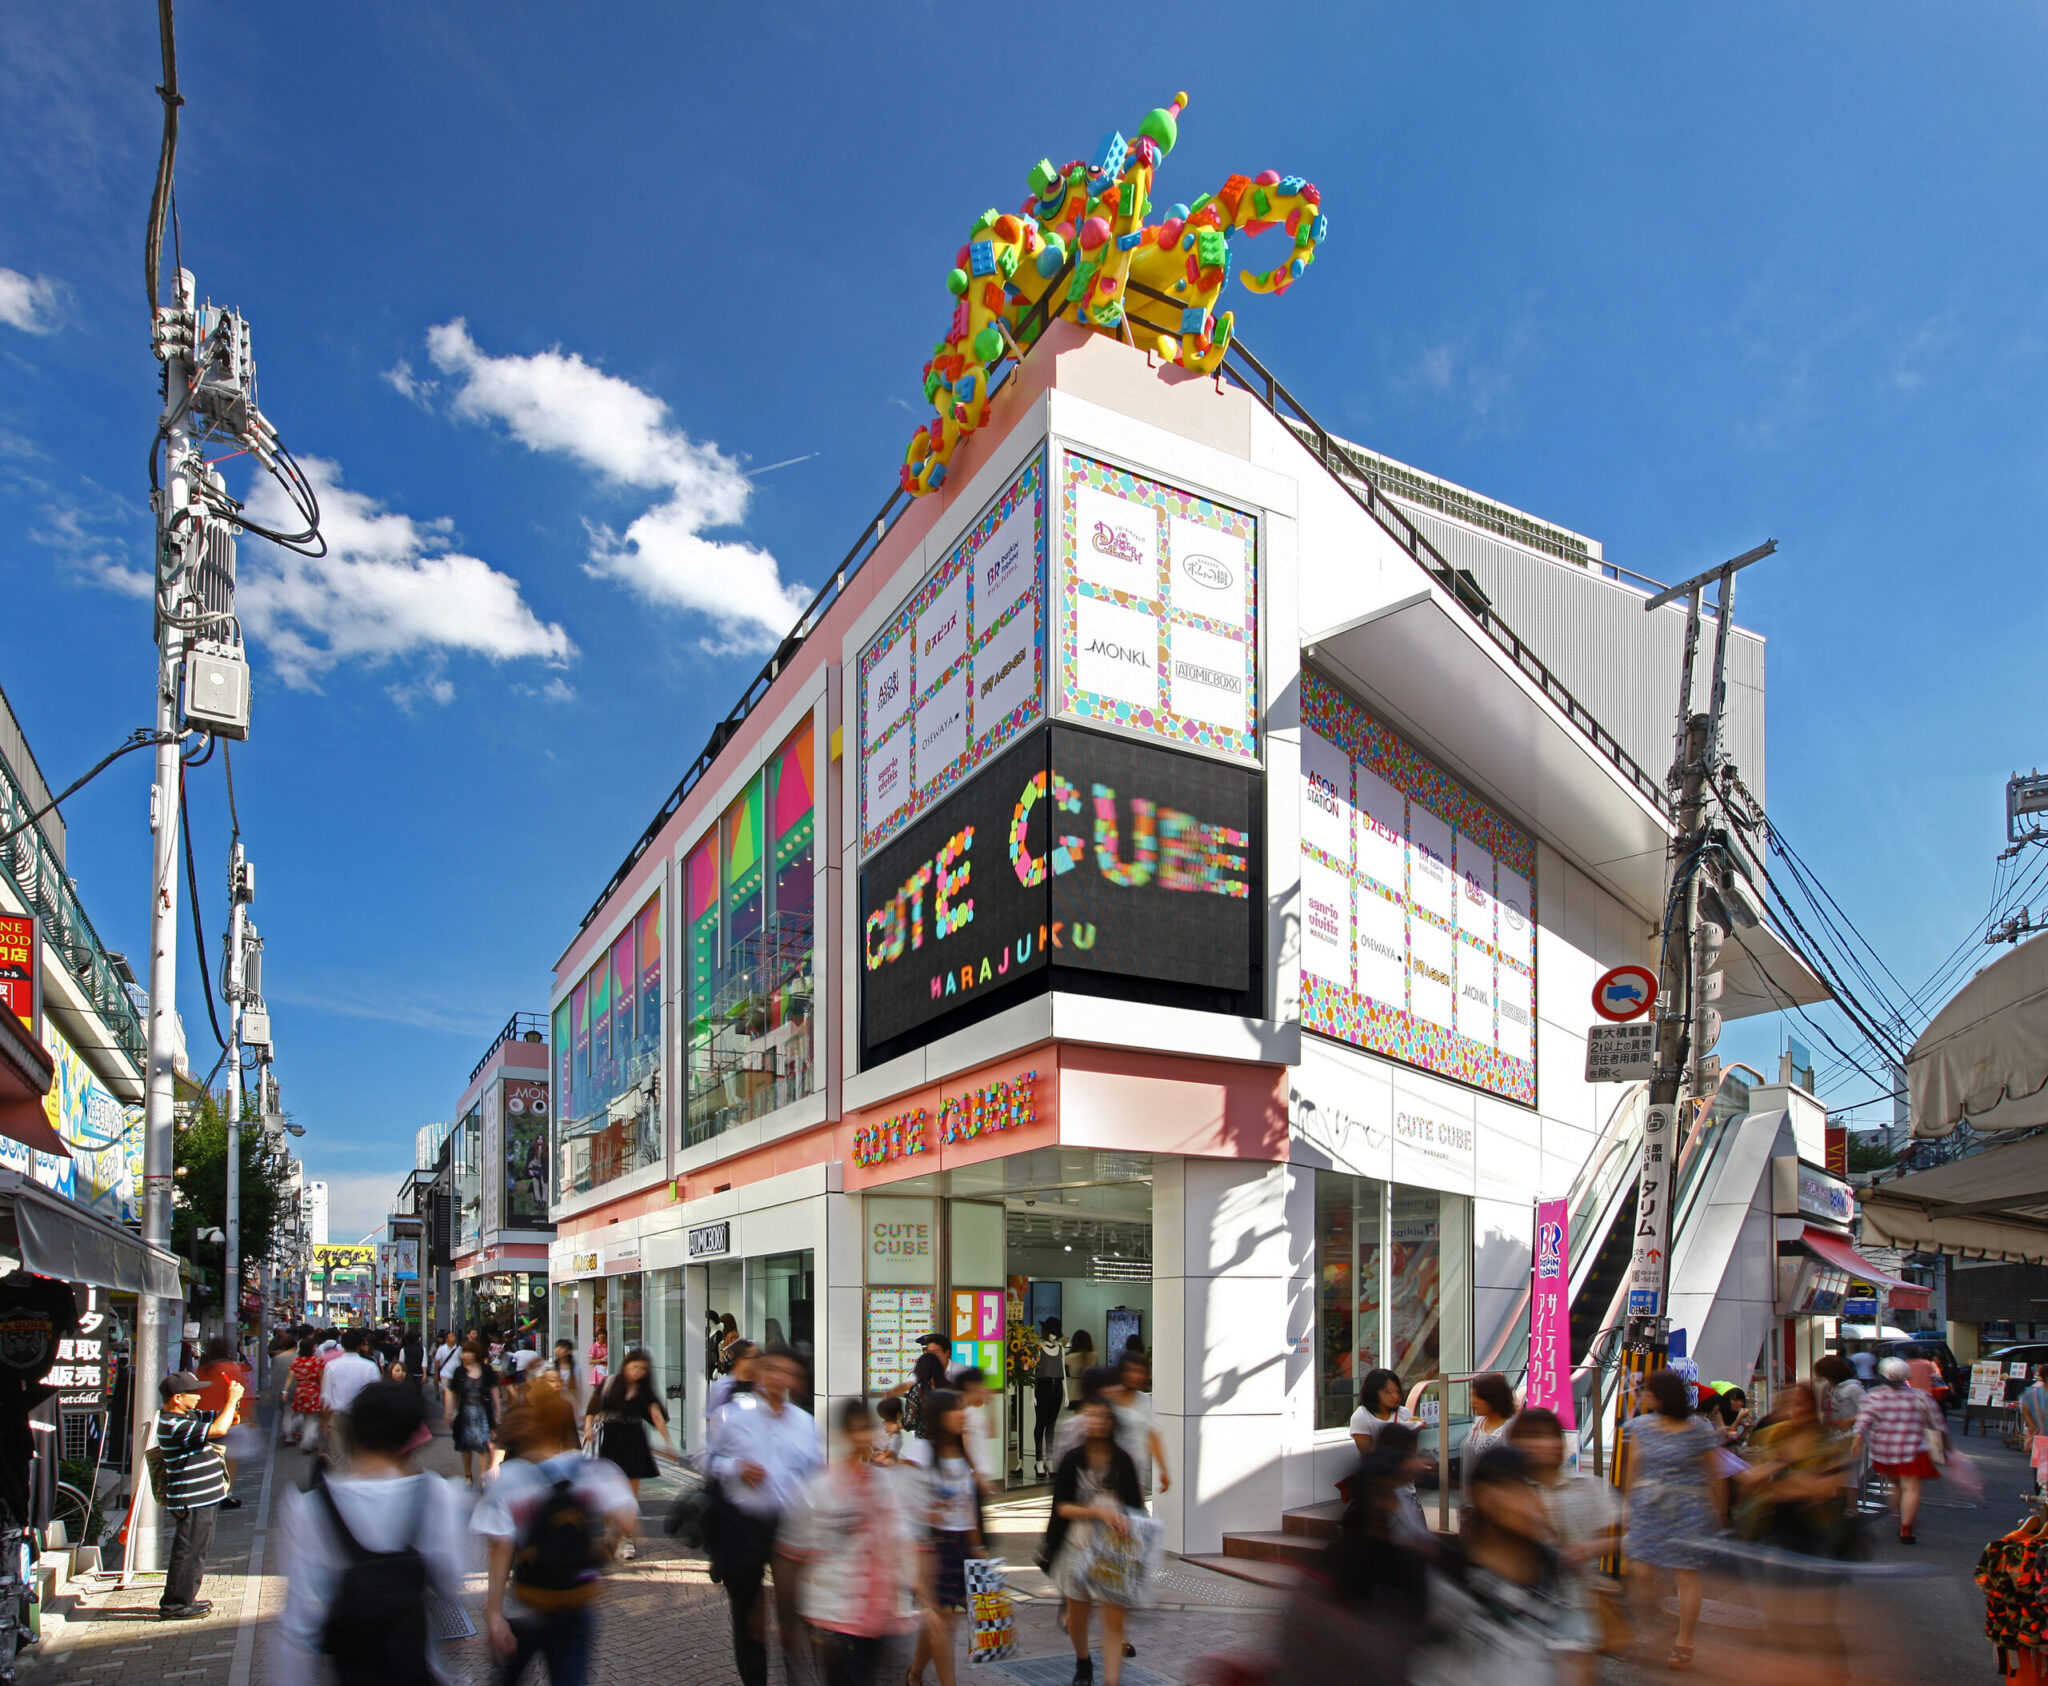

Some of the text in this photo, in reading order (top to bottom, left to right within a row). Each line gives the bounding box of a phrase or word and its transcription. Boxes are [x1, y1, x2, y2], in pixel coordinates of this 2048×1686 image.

[987, 561, 1000, 586] BR
[1084, 638, 1151, 669] MONKI
[878, 668, 899, 697] ASOBI
[1177, 662, 1240, 693] ATOMICBOXX
[877, 682, 899, 712] STATION
[922, 715, 954, 750] OSEWAYA
[1309, 770, 1338, 799] ASOBI
[1306, 789, 1339, 818] STATION
[866, 769, 1249, 972] CUTE CUBE
[1309, 897, 1338, 921] sanrio
[1309, 913, 1339, 937] vivitix
[930, 920, 1096, 1000] HARAJUKU
[1360, 934, 1396, 960] OSEWAYA
[1590, 1039, 1651, 1053] 2t以上の貨物
[1592, 1026, 1652, 1039] 最大積載量
[1589, 1052, 1650, 1066] 居住者用車両
[1589, 1067, 1621, 1079] を除く
[851, 1070, 1037, 1169] CUTE CUBE
[1397, 1112, 1472, 1151] CUTE CUBE
[1651, 1143, 1663, 1162] 原宿
[1637, 1180, 1658, 1237] タリム
[873, 1223, 928, 1239] CUTE
[1540, 1223, 1561, 1256] BR
[873, 1240, 928, 1255] CUBE
[56, 1339, 102, 1361] 買取
[39, 1365, 101, 1387] 販売
